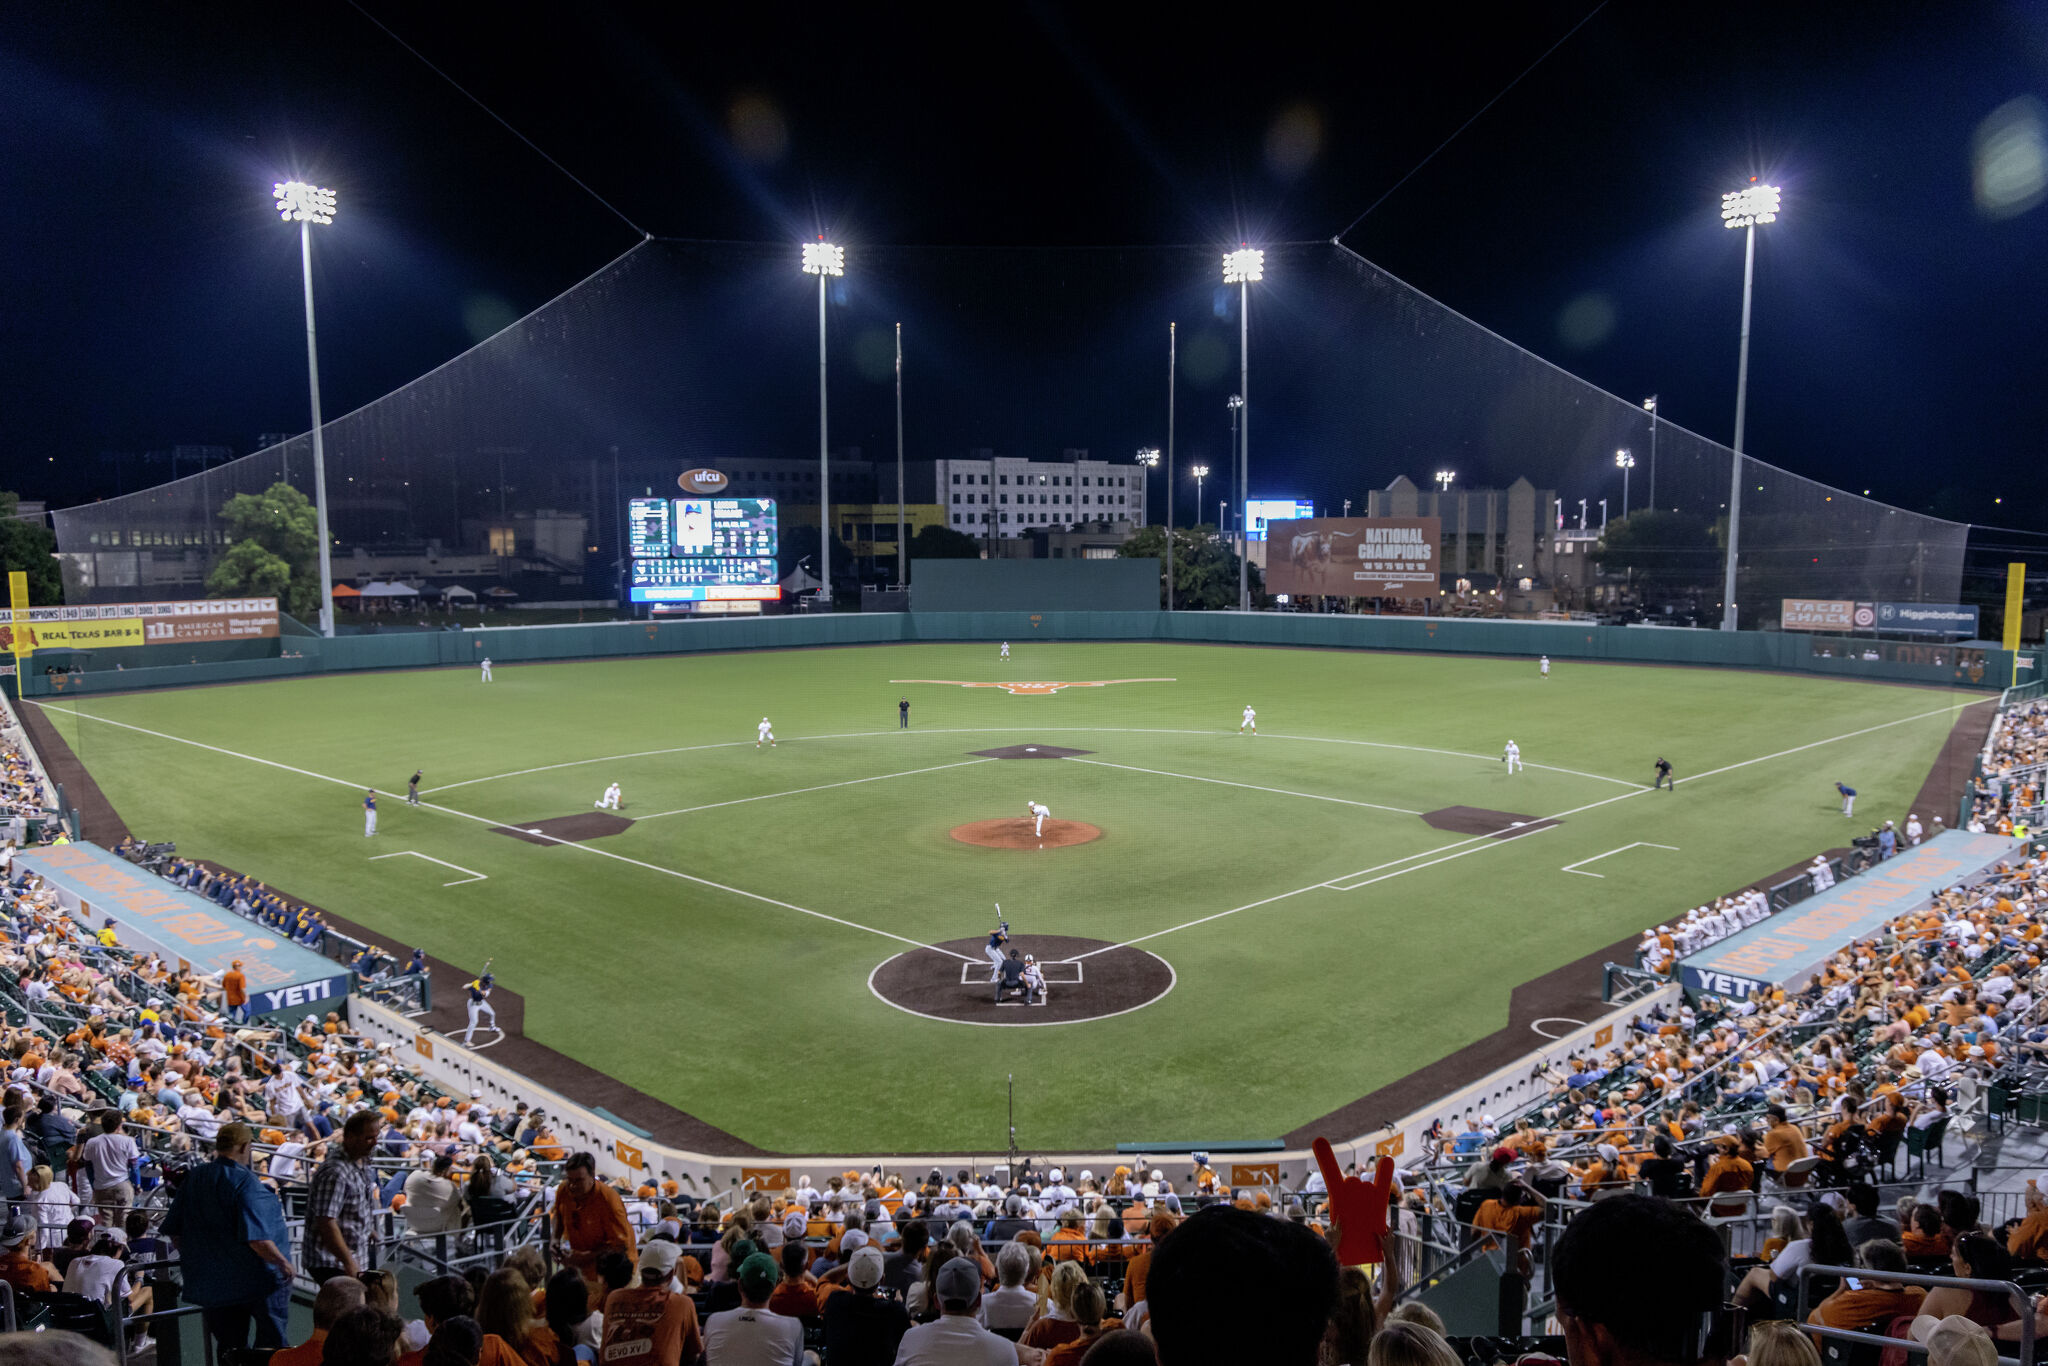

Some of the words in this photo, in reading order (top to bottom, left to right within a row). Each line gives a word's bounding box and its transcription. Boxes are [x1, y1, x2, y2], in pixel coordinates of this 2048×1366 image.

[694, 470, 720, 482] ufcu
[1366, 528, 1424, 543] NATIONAL
[1358, 544, 1432, 559] CHAMPIONS
[1792, 602, 1843, 613] TACO
[1786, 612, 1851, 623] SHACK
[1899, 608, 1975, 620] Higginbotham
[177, 622, 225, 630] AMERICAN
[42, 632, 67, 640] REAL
[69, 630, 100, 640] TEXAS
[176, 628, 225, 637] CAMPUS
[1706, 936, 1809, 975] UFCU
[1696, 969, 1761, 997] YETI
[265, 979, 331, 1011] YETI
[607, 1346, 628, 1359] BEVO
